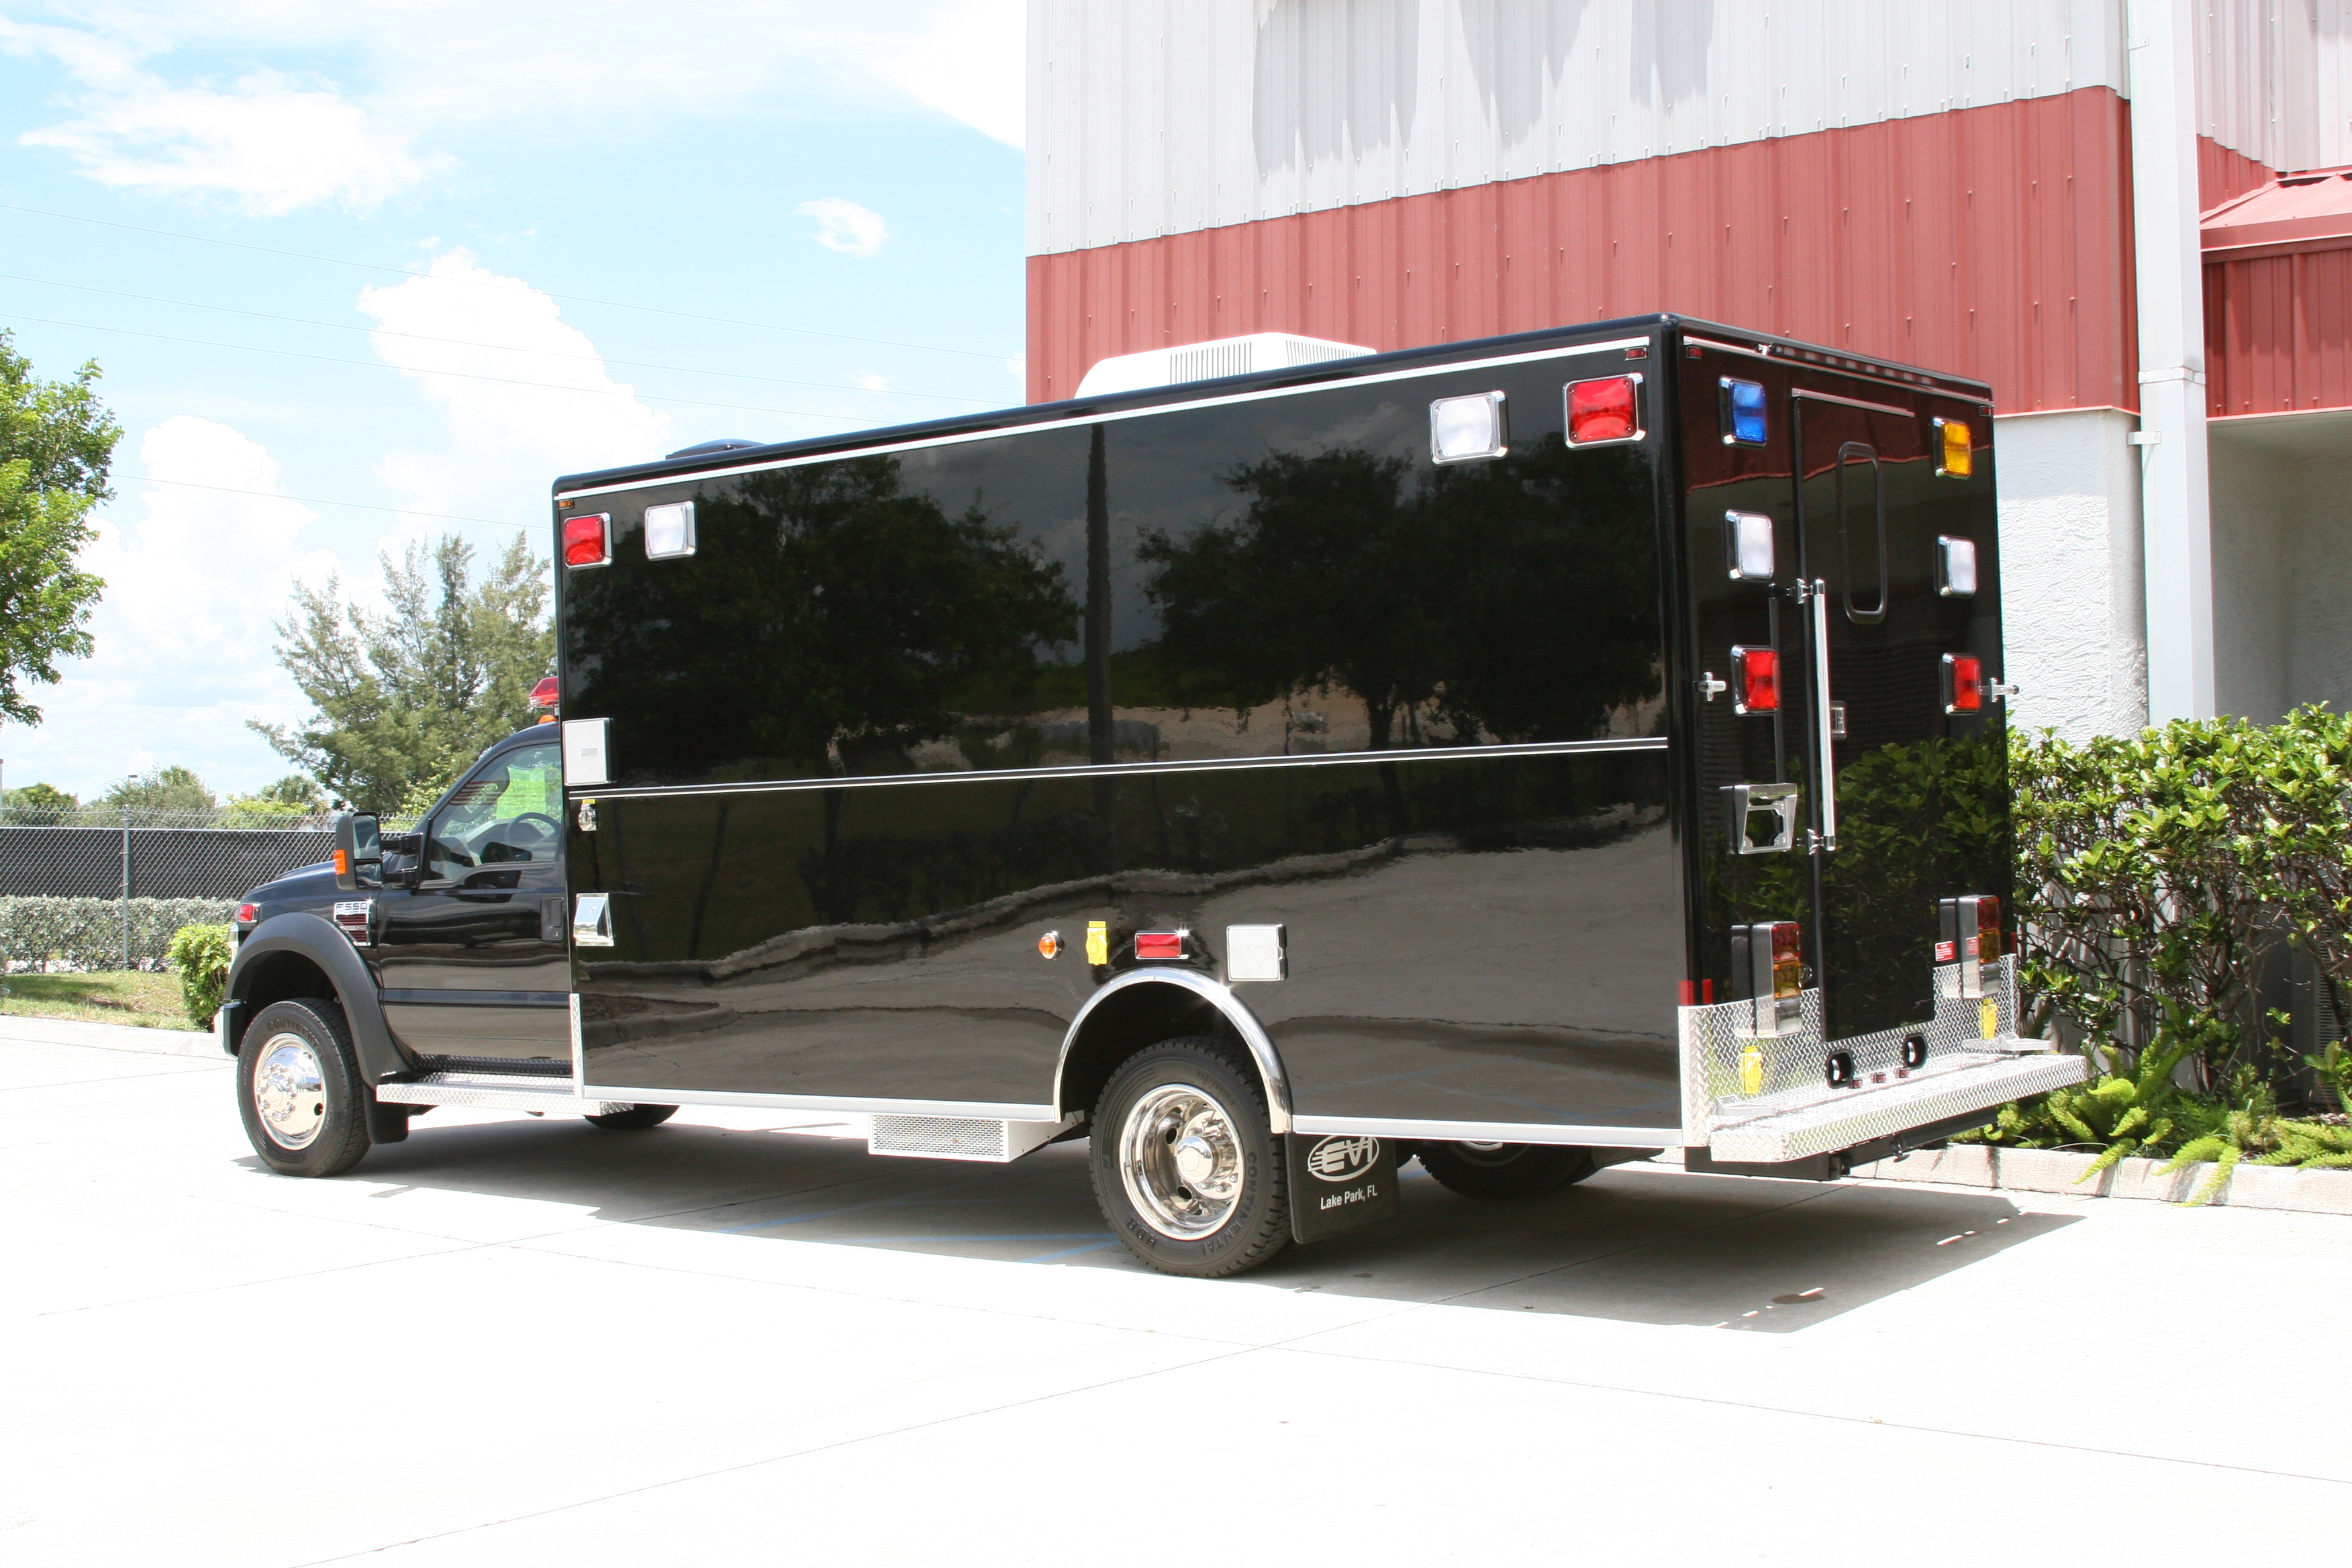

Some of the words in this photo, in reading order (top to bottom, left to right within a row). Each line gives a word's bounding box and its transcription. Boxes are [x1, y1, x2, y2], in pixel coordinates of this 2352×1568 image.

[1200, 1151, 1259, 1256] CONTINENTAL
[1320, 1194, 1342, 1210] Lake
[1344, 1188, 1365, 1205] Park,
[1367, 1184, 1378, 1198] FL
